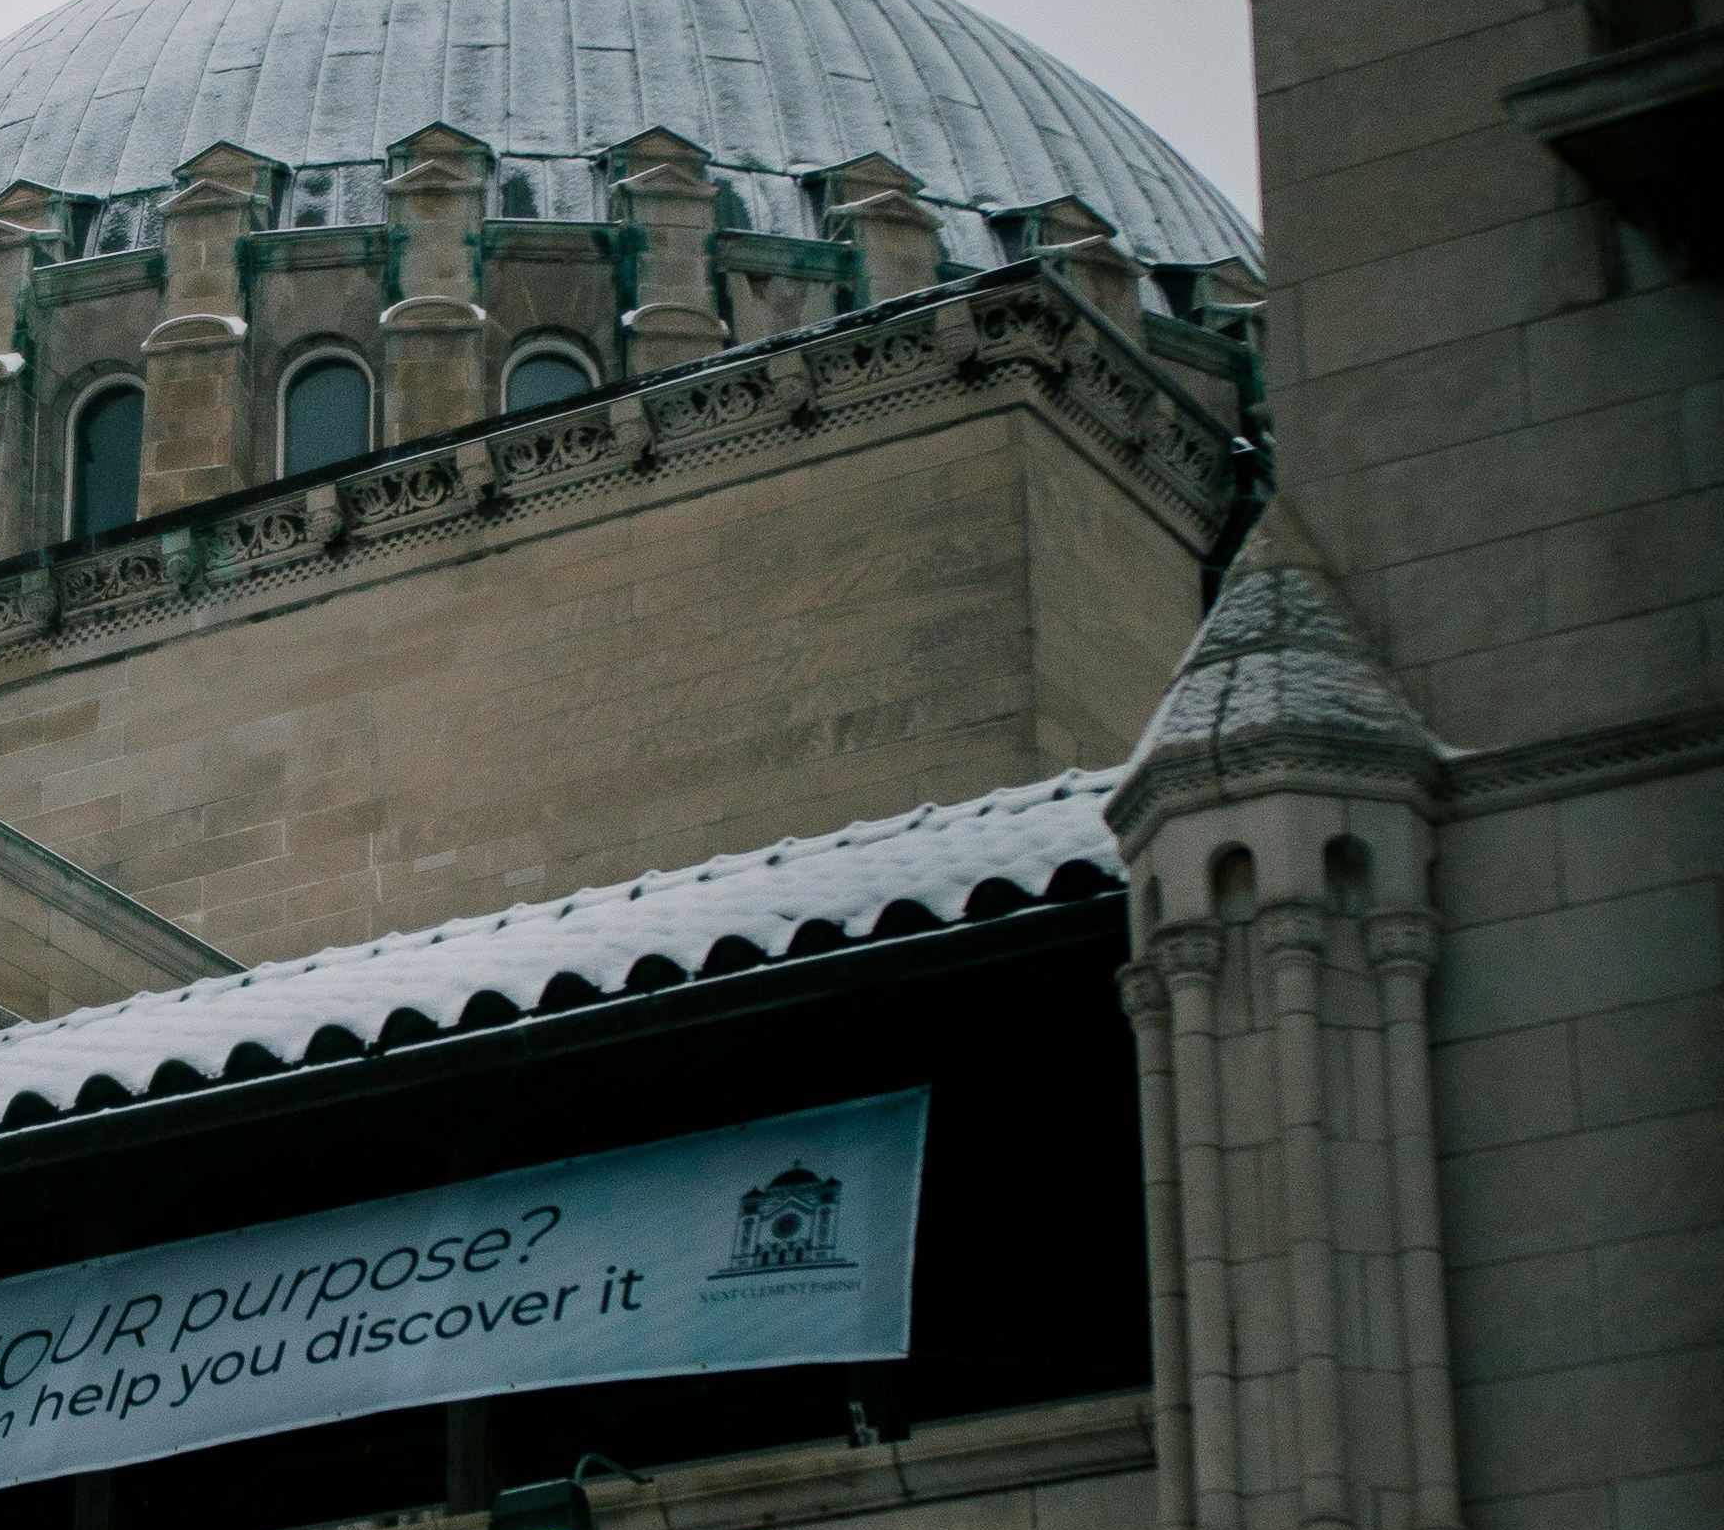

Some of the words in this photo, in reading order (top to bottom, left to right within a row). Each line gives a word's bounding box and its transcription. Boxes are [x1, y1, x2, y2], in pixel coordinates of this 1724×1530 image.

[28, 1367, 161, 1427] help
[170, 1337, 286, 1408] you
[305, 1283, 580, 1365] discover
[600, 1265, 644, 1316] it
[171, 1205, 562, 1353] purpose?
